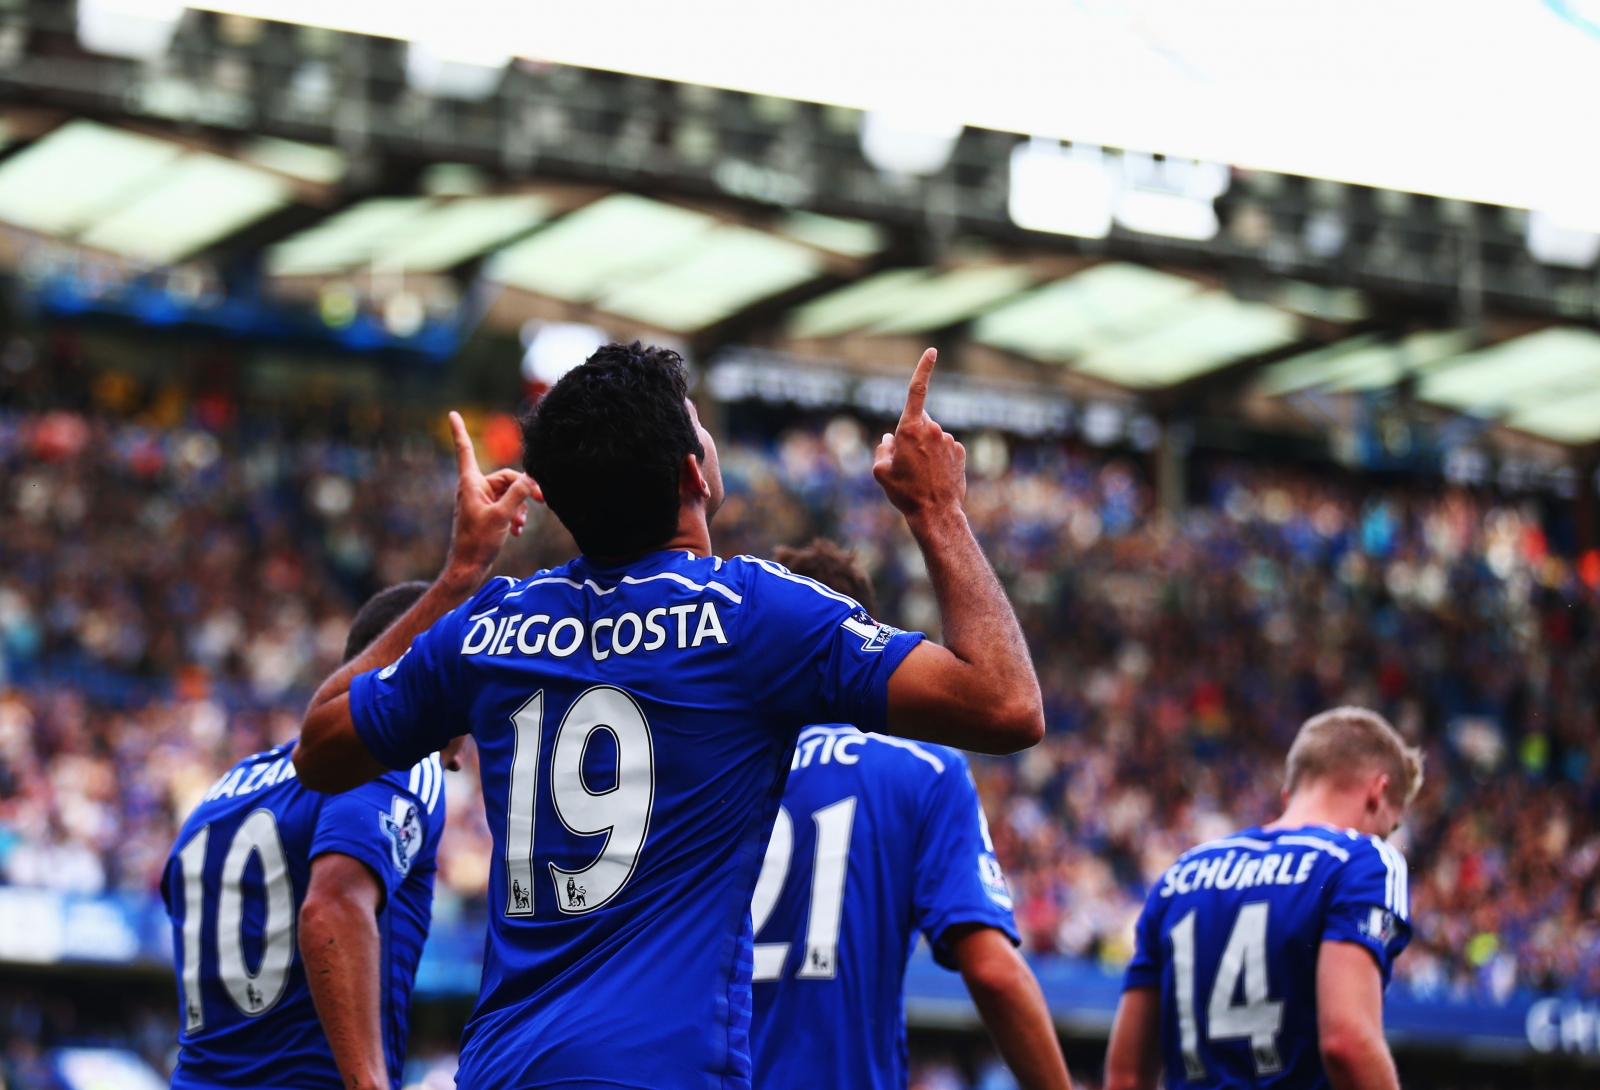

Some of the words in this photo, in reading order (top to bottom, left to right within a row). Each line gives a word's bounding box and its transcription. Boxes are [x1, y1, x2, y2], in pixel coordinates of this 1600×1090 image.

[460, 613, 585, 658] DIEGO
[590, 601, 729, 662] COSTA
[504, 685, 655, 916] 19
[791, 734, 868, 771] TIC
[180, 808, 294, 1036] 10
[1159, 849, 1319, 898] SCHÜRRLE
[1169, 902, 1283, 1082] 14
